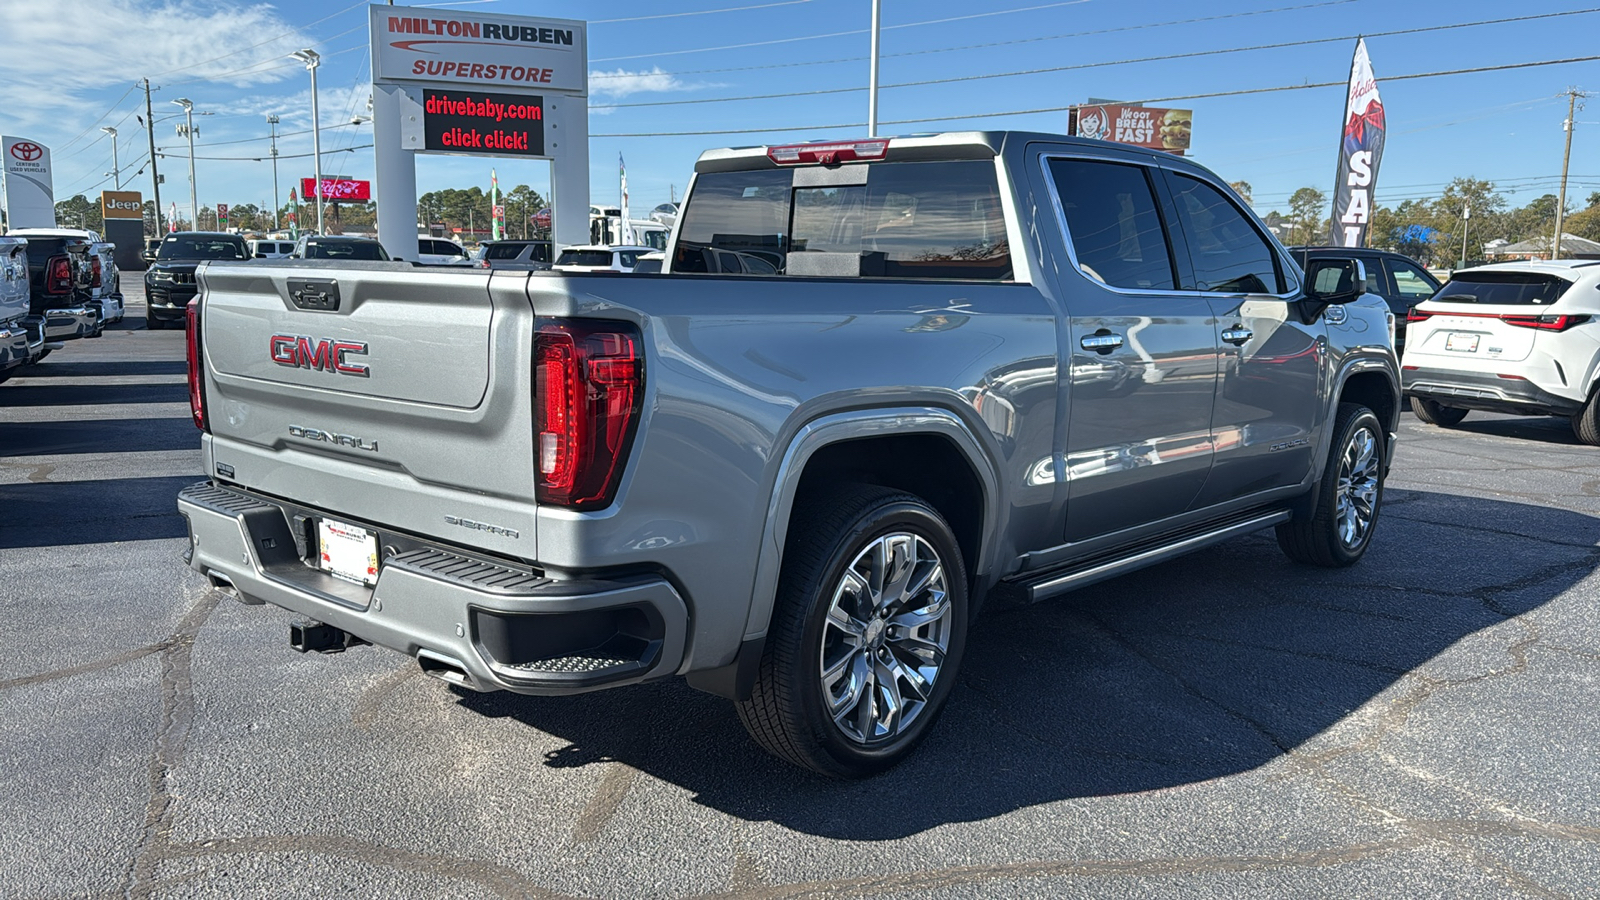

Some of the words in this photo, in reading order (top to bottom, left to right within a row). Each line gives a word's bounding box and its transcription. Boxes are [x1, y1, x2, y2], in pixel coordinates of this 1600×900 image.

[388, 17, 480, 38] MILTON
[483, 23, 573, 46] RUBEN
[412, 60, 553, 83] SUPERSTORE
[426, 95, 542, 122] drivebaby.com
[1121, 107, 1132, 120] We
[1133, 111, 1151, 119] GOT
[1115, 118, 1155, 130] BREAK
[442, 128, 481, 148] click
[484, 131, 528, 150] click!
[1114, 128, 1155, 144] FAST
[106, 198, 140, 211] Jeep
[270, 332, 371, 378] GMC
[289, 424, 379, 453] DENALI
[444, 514, 520, 539] SIERRA
